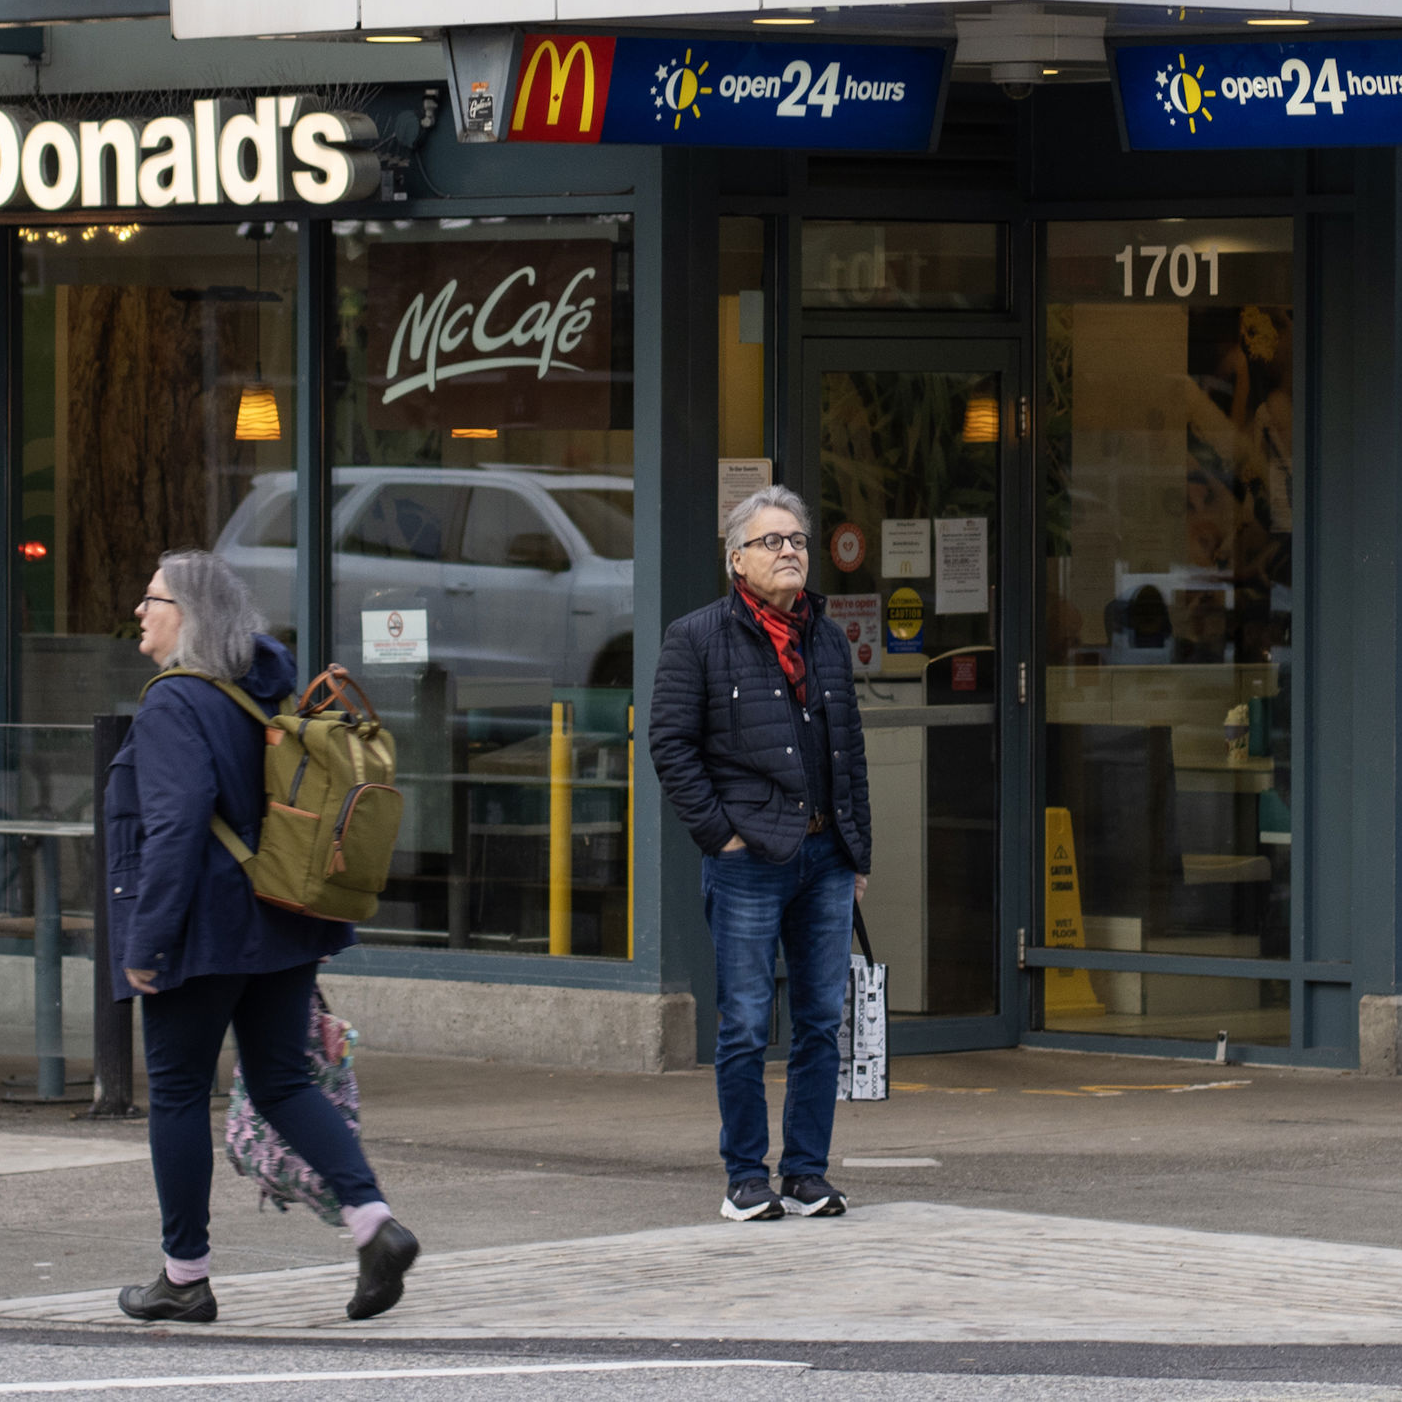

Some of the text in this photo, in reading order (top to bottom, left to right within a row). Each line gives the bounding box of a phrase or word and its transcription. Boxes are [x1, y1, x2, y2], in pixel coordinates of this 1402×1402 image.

[719, 59, 905, 118] open 24 hours
[1221, 73, 1284, 106] open
[1281, 58, 1347, 116] 24
[1115, 244, 1222, 297] 1701
[384, 266, 596, 391] McCafé
[1052, 928, 1077, 938] FLOOR
[1055, 918, 1073, 927] WET
